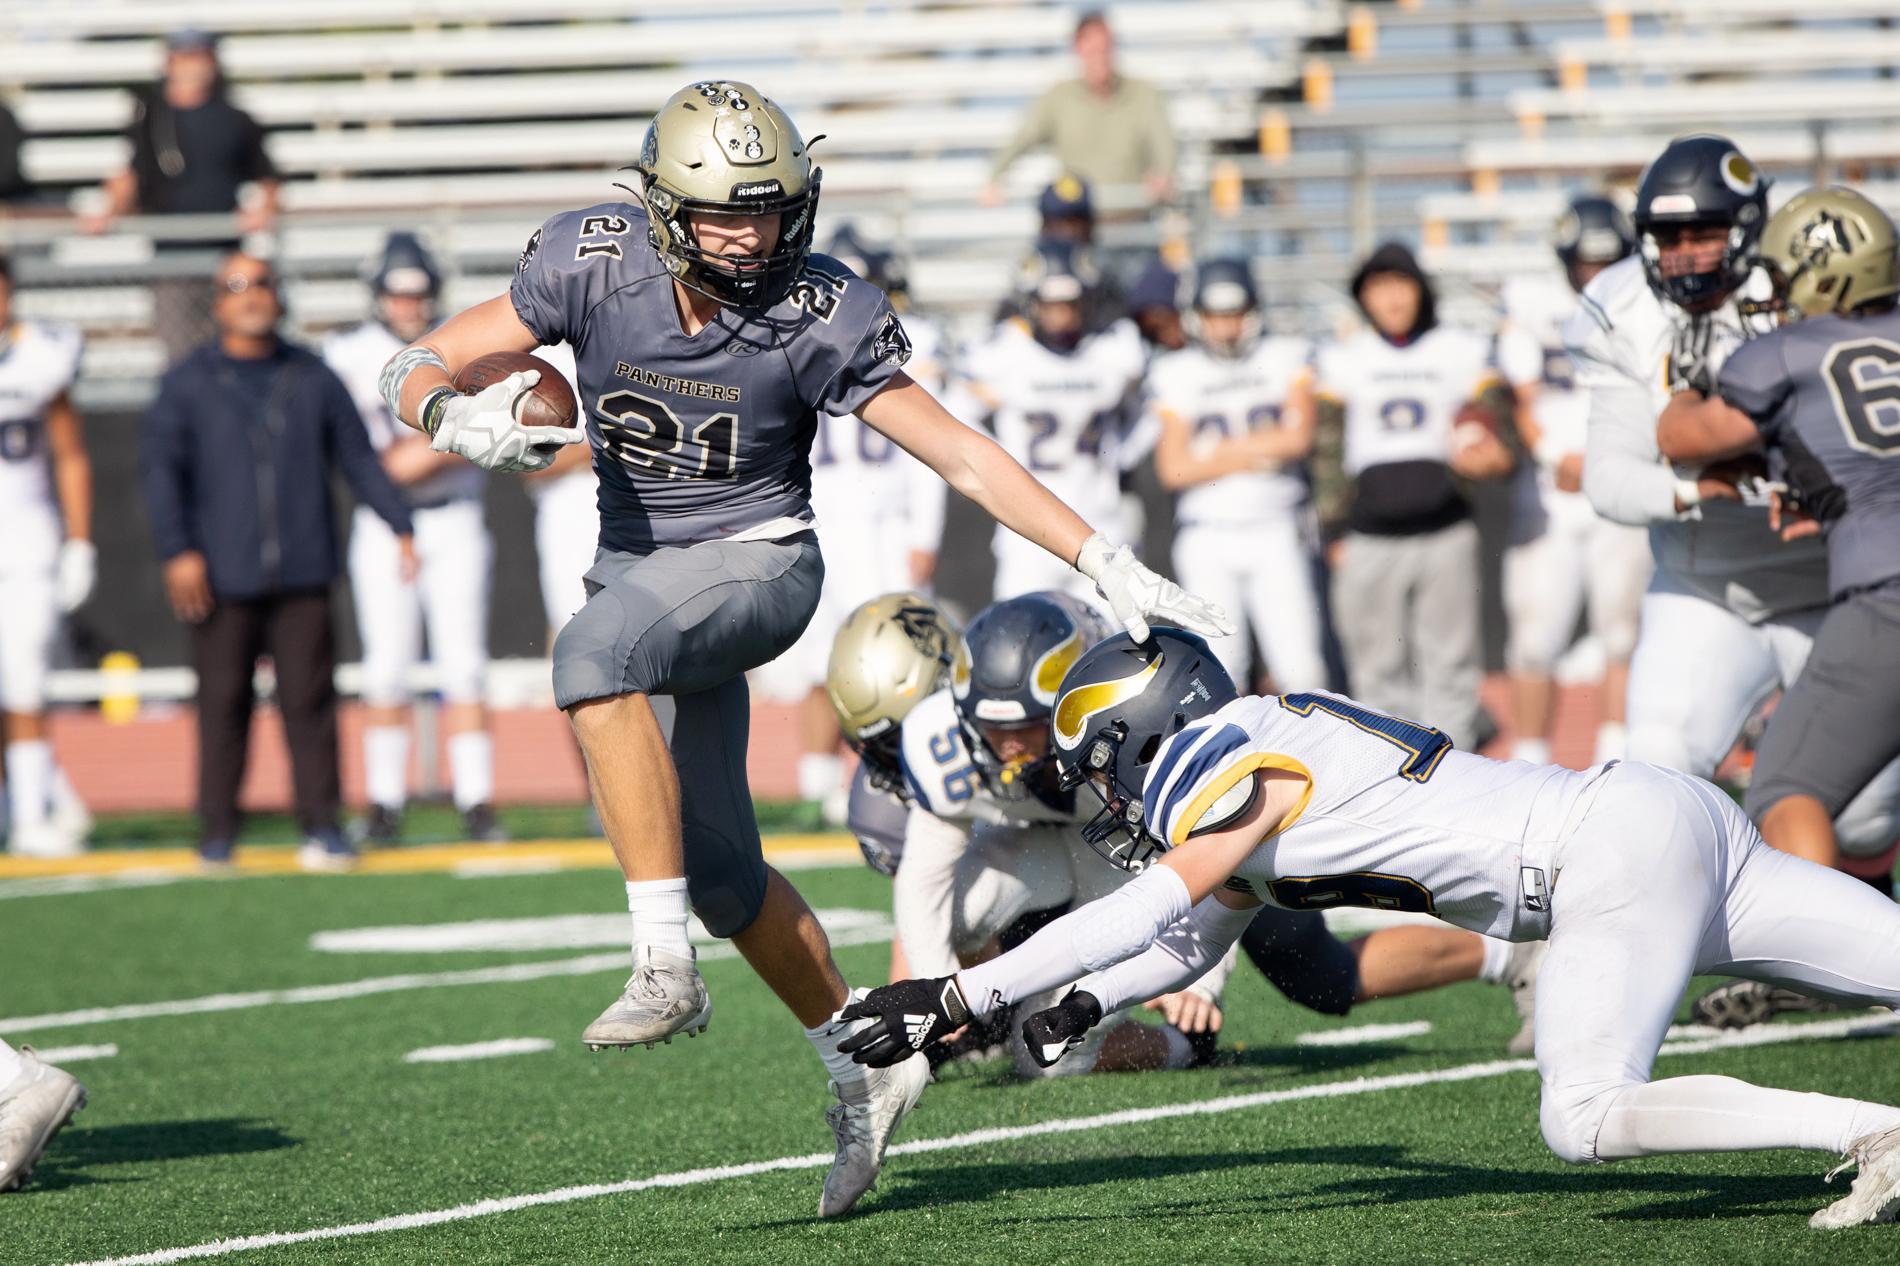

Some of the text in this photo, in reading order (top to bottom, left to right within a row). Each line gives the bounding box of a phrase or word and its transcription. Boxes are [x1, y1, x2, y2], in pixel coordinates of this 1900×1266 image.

[737, 183, 779, 197] Riddell
[575, 215, 631, 261] 21
[784, 208, 809, 242] Riddell
[788, 266, 848, 325] 21
[615, 361, 741, 402] PANTHERS
[596, 389, 740, 482] 21
[929, 723, 982, 802] 56
[911, 1012, 938, 1049] adidas
